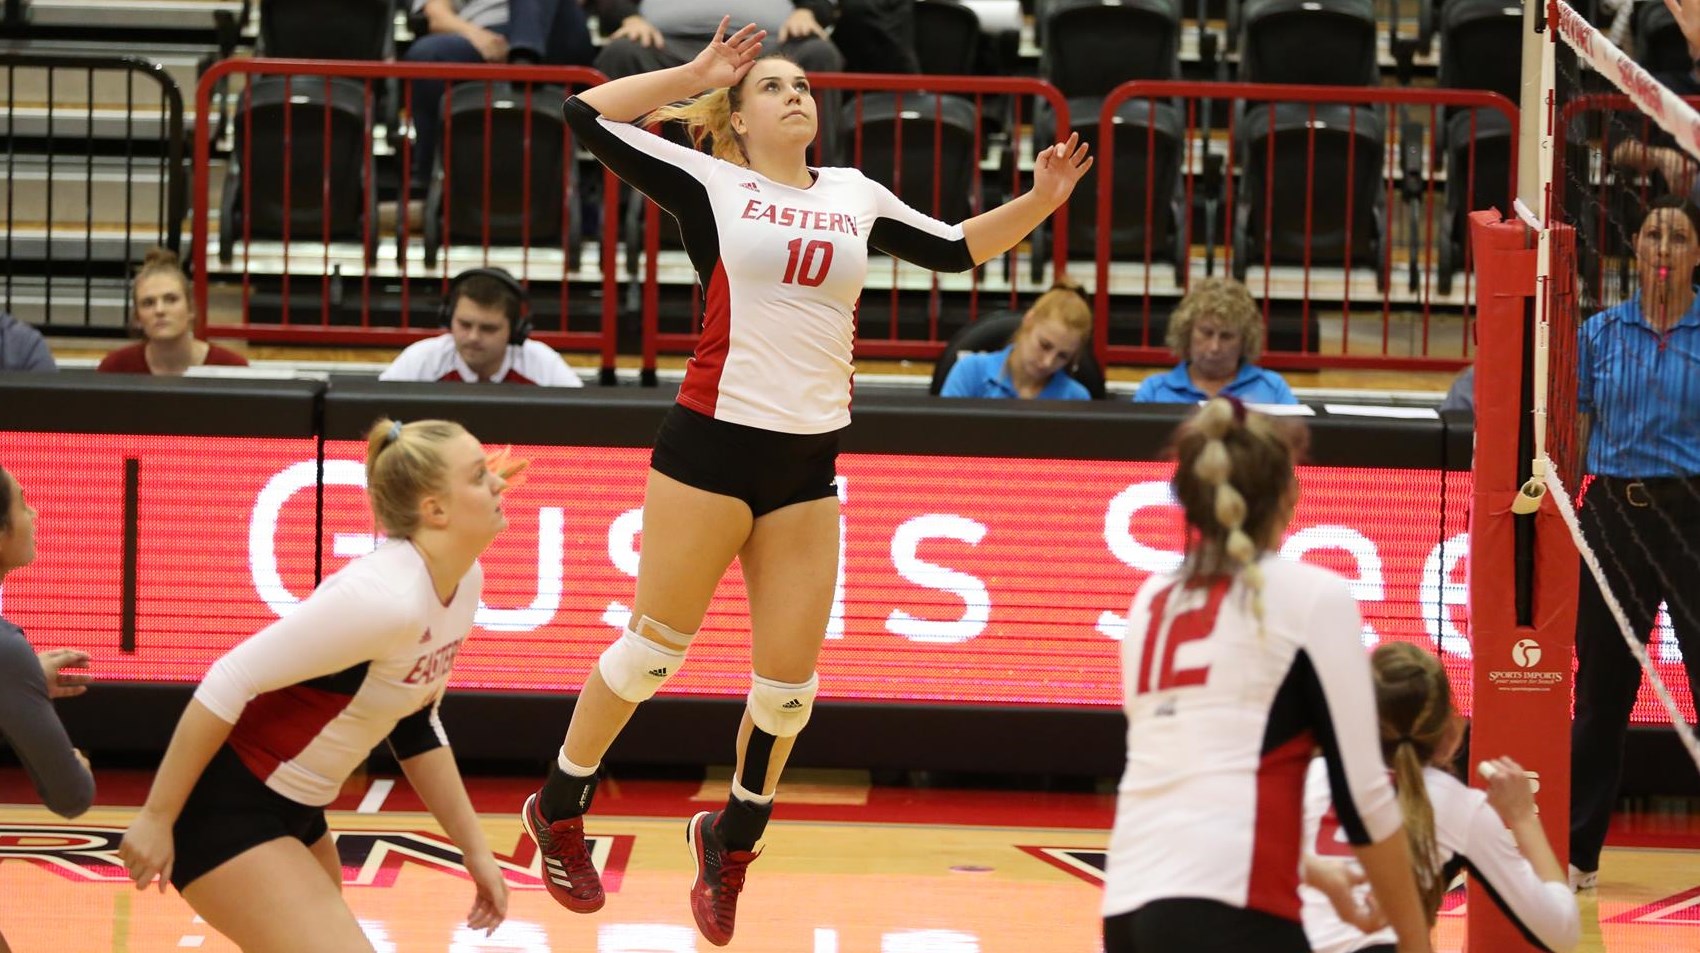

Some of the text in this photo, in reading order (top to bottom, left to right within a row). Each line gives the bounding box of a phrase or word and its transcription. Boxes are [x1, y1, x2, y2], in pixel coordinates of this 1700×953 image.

[741, 198, 858, 236] EASTERN
[781, 237, 834, 288] 10
[1137, 573, 1233, 695] 12
[1488, 671, 1522, 682] SPORTS
[1523, 671, 1563, 683] IMPORTS
